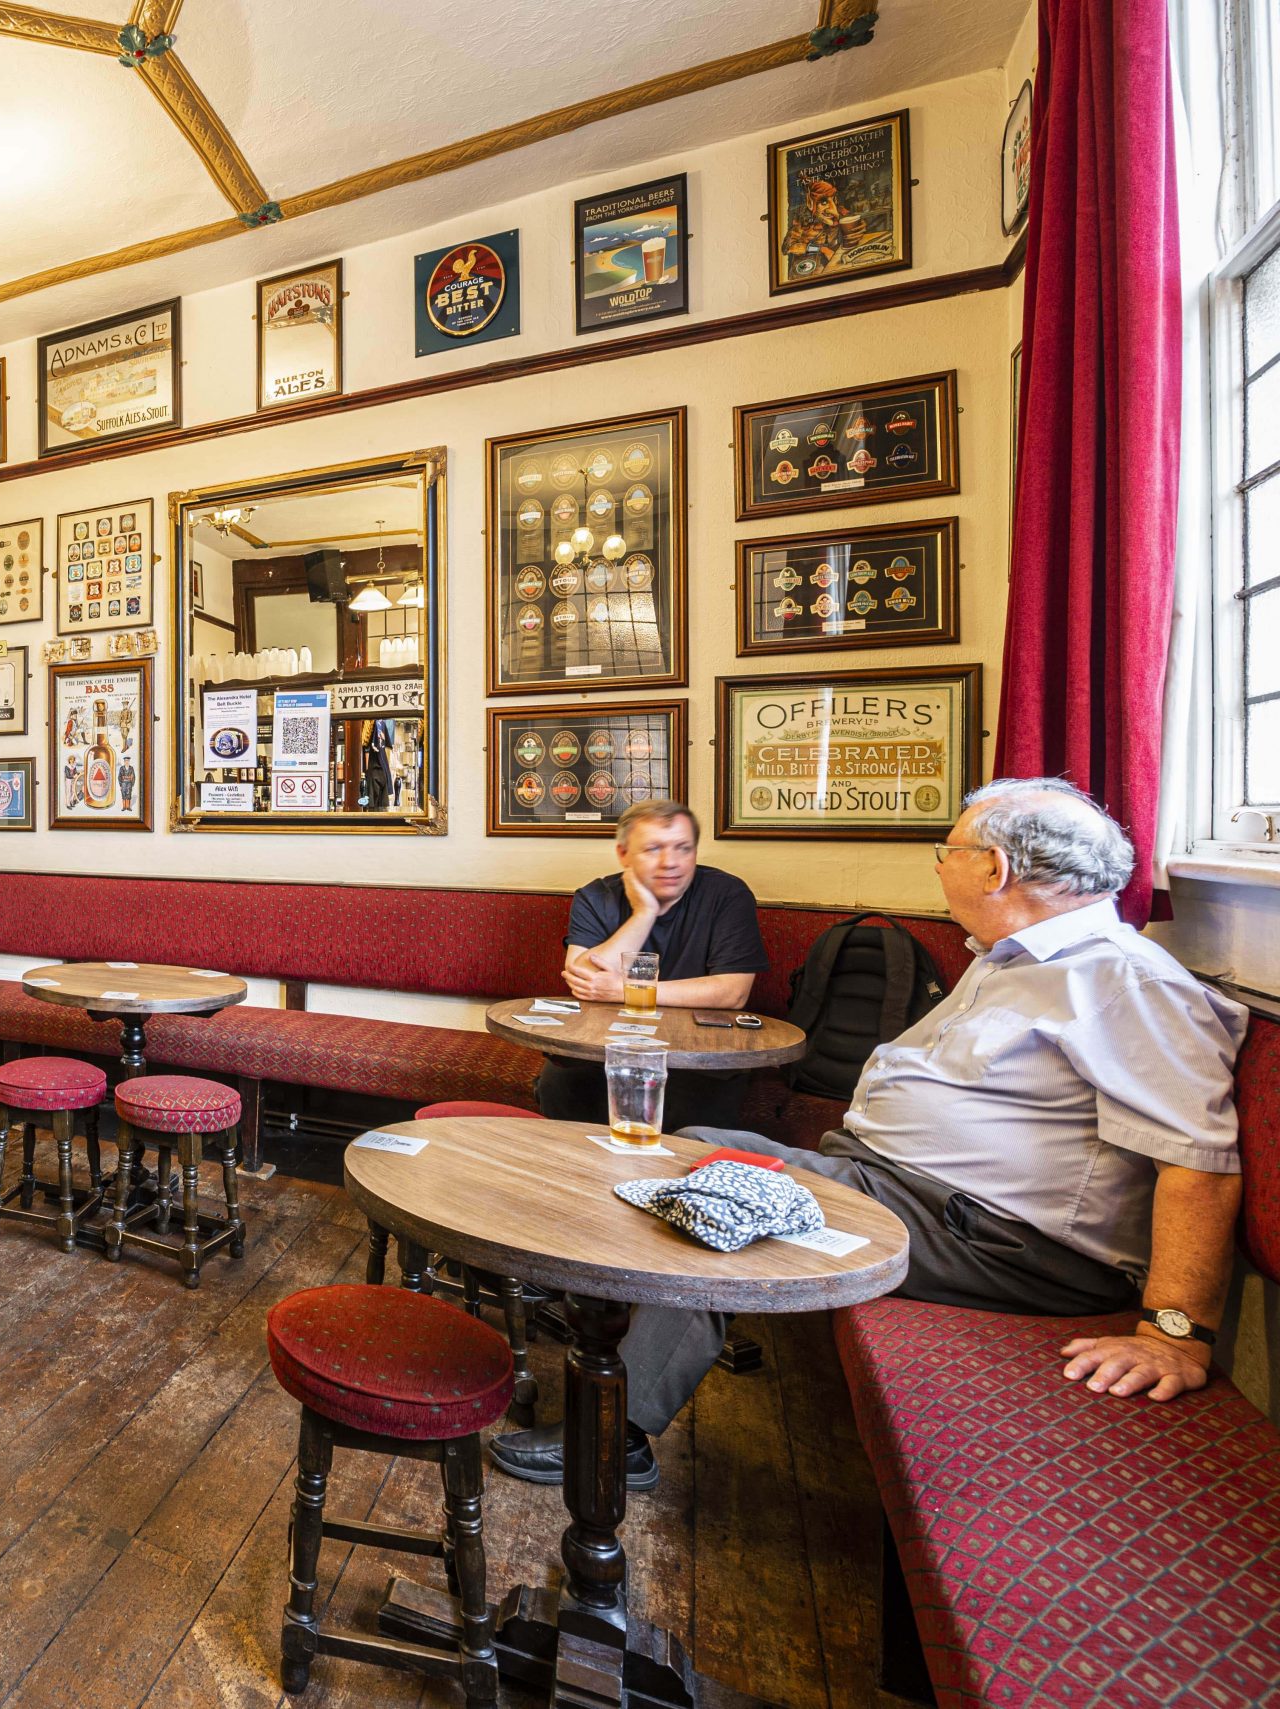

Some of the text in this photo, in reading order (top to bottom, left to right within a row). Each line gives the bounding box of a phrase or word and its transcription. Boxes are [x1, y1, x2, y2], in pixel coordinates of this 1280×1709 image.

[830, 139, 848, 150] THE
[849, 129, 885, 146] MATTER
[798, 149, 886, 178] AFRAID YOU MIGHT
[584, 187, 675, 217] TRADITIONAL BEERS
[585, 195, 674, 223] FROM THE YORKSHIRE COAST
[847, 244, 890, 259] HOBGOBLIN
[444, 276, 484, 292] COURAGE
[434, 281, 494, 308] BEST
[446, 299, 484, 315] BITTER
[50, 334, 121, 378] ADNAMS
[124, 334, 133, 350] &
[274, 369, 324, 385] BURTON
[273, 376, 326, 398] ALES
[96, 411, 124, 433] SUFFOLK
[124, 410, 141, 427] ALES
[555, 613, 574, 621] STOUT
[76, 679, 94, 687] DRINK
[85, 683, 115, 694] BASS
[806, 718, 862, 729] BREWERY
[785, 730, 811, 740] DERBY
[824, 728, 869, 739] AVENDISH
[758, 745, 932, 763] CELEBRATED
[790, 762, 831, 776] BITTER
[834, 764, 843, 774] &
[845, 761, 897, 776] STRONG
[901, 761, 935, 775] ALES
[831, 780, 852, 788] AND
[777, 786, 912, 811] NOTED STOUT
